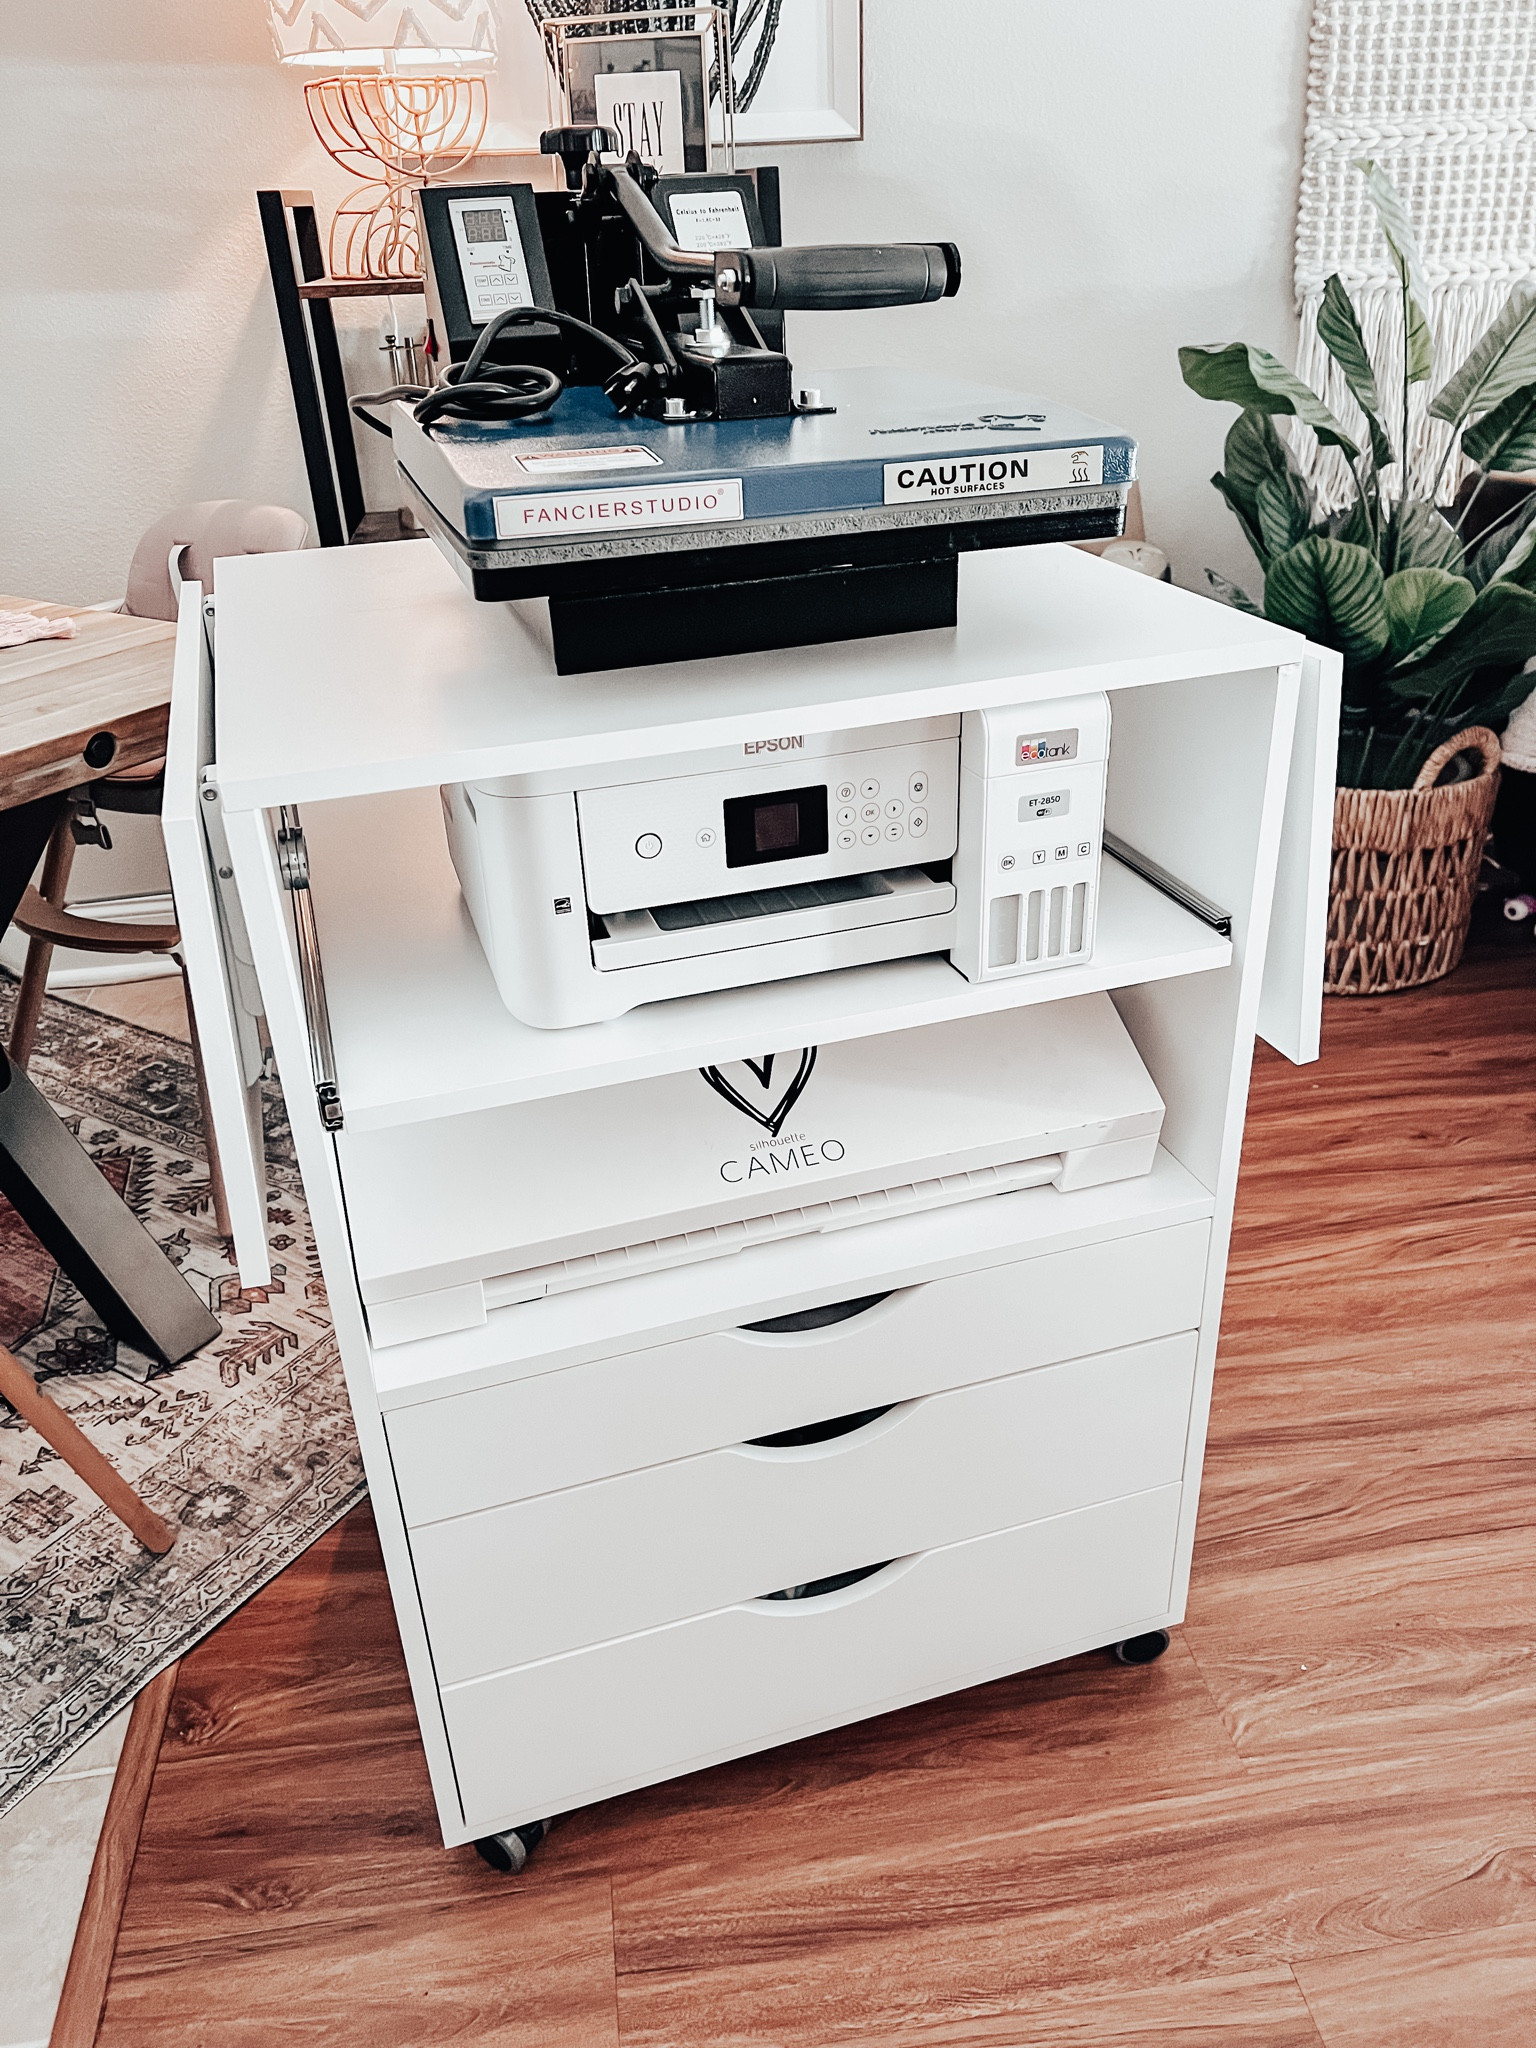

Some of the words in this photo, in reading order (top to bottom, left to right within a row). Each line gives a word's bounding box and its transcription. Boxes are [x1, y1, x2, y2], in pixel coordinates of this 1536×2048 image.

[613, 101, 664, 158] STAY
[708, 206, 740, 214] Fahrenheit
[897, 459, 1029, 489] CAUTION
[931, 486, 950, 496] HOT
[953, 481, 1005, 494] SURFACES
[523, 494, 717, 524] FANCIERSTUDIO
[744, 735, 803, 755] EPSON
[1028, 795, 1061, 807] ET-2850
[1036, 853, 1042, 861] Y
[1057, 849, 1066, 857] M
[1080, 845, 1087, 853] C
[749, 1133, 807, 1152] silhouette
[720, 1139, 845, 1183] CAMEO
